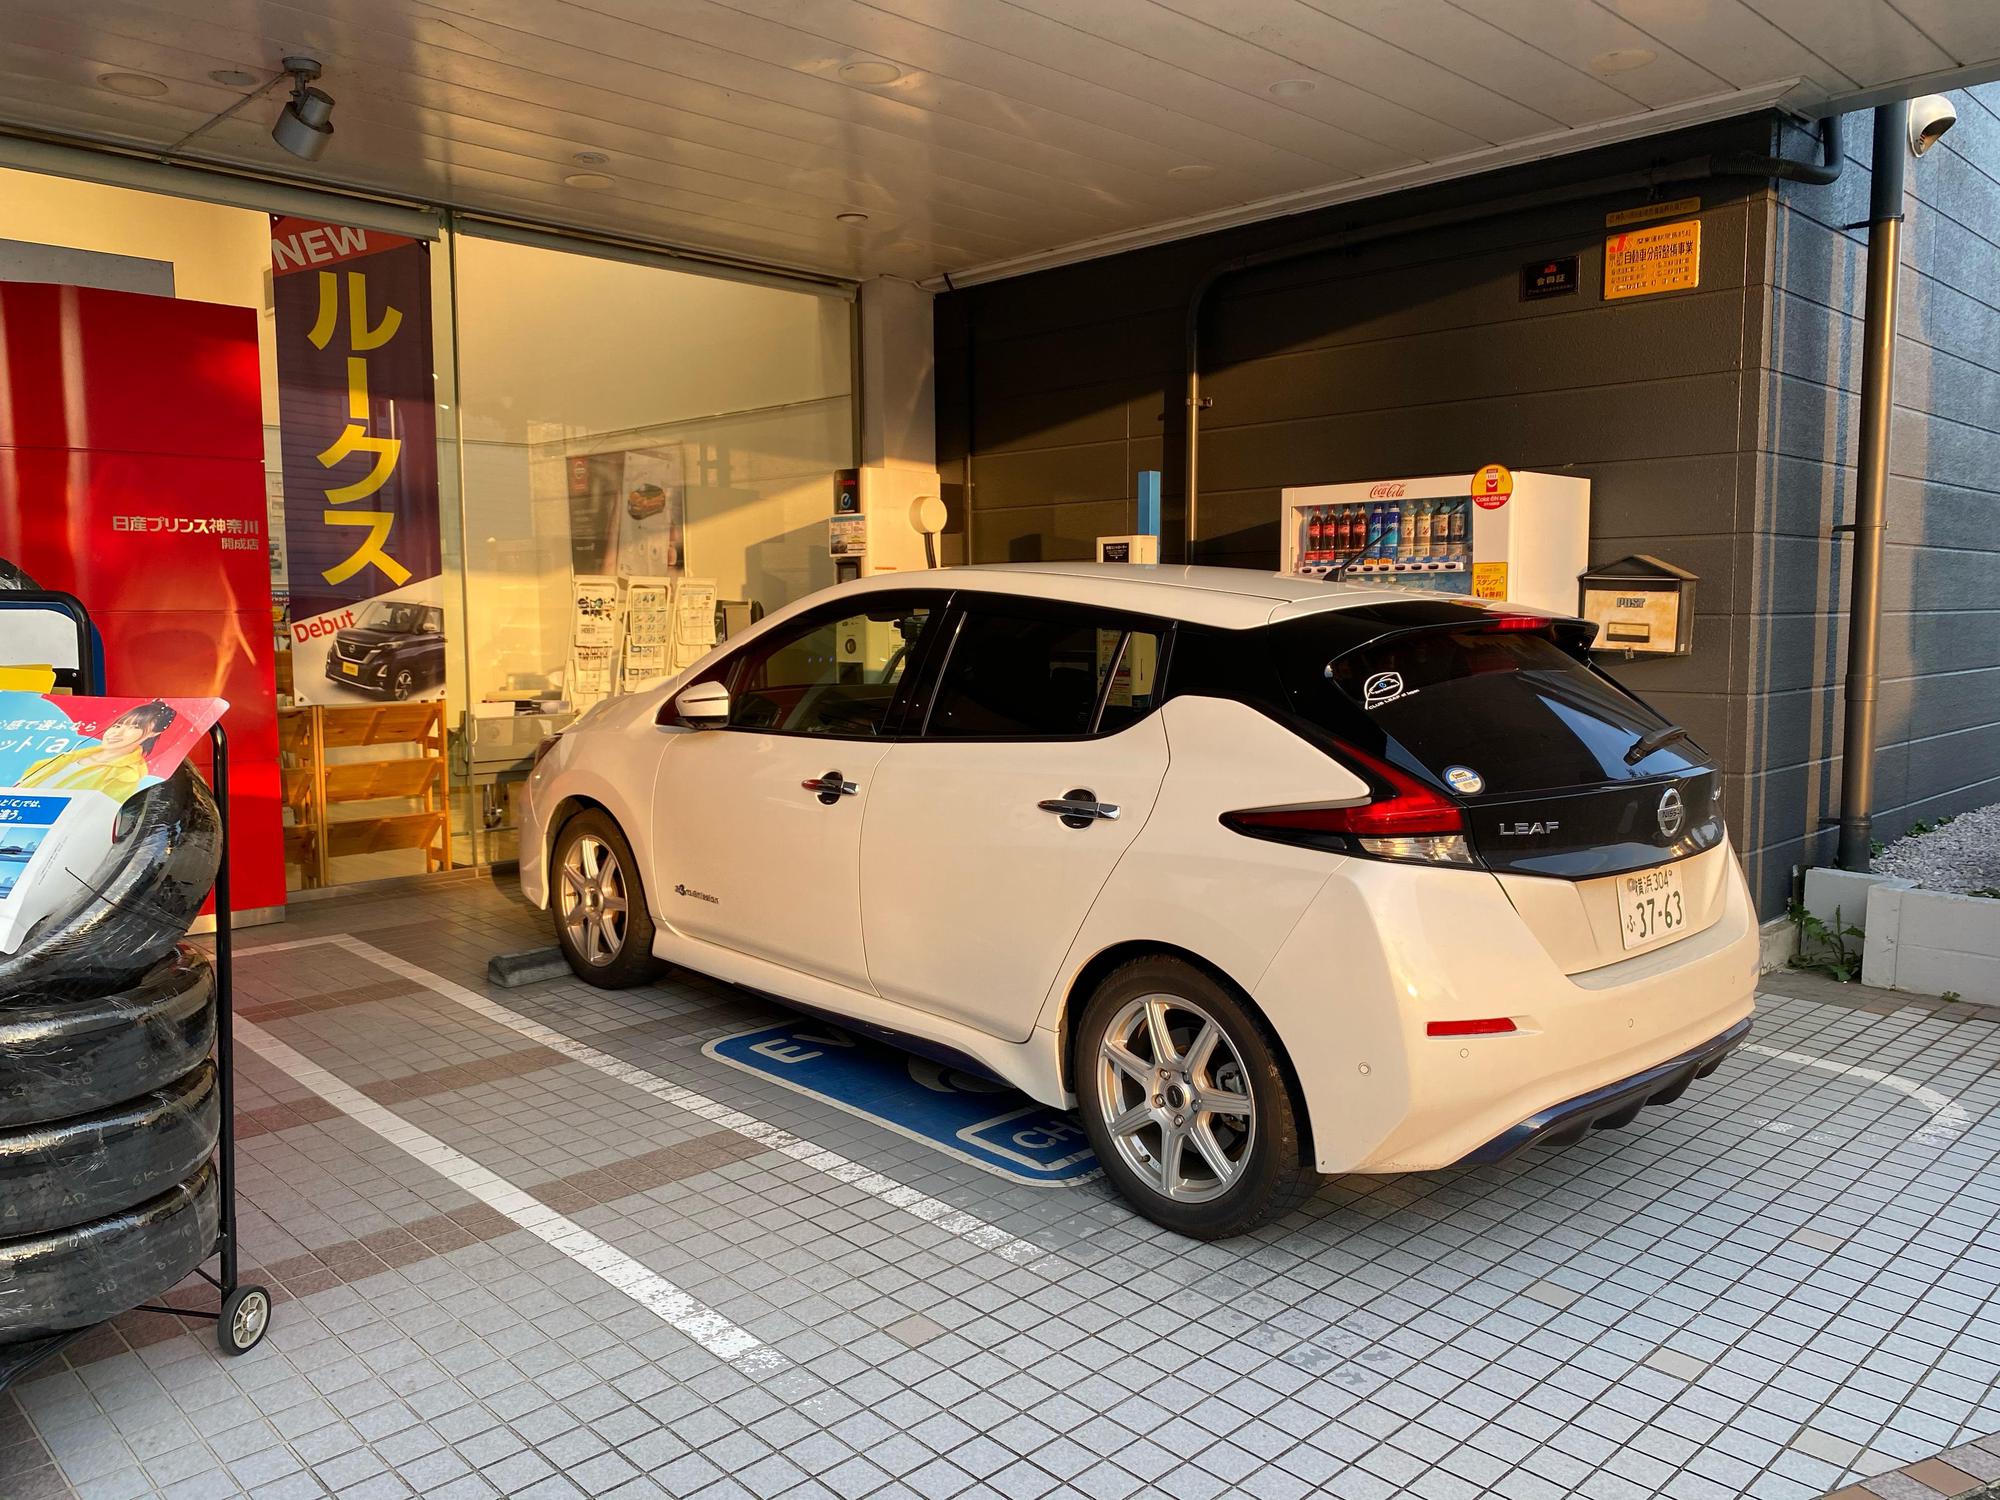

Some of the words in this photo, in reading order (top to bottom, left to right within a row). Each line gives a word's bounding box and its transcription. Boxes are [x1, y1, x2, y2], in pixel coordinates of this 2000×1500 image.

[272, 226, 368, 271] NEW
[307, 271, 413, 587] ルークス
[112, 515, 260, 535] 日産プリンス神奈川
[221, 537, 260, 551] 開成店
[1616, 597, 1646, 608] POST
[293, 609, 354, 644] Debut
[1499, 821, 1560, 836] LEAF
[1626, 914, 1636, 933] ふ
[749, 1027, 857, 1064] EV
[1012, 1115, 1086, 1149] CH
